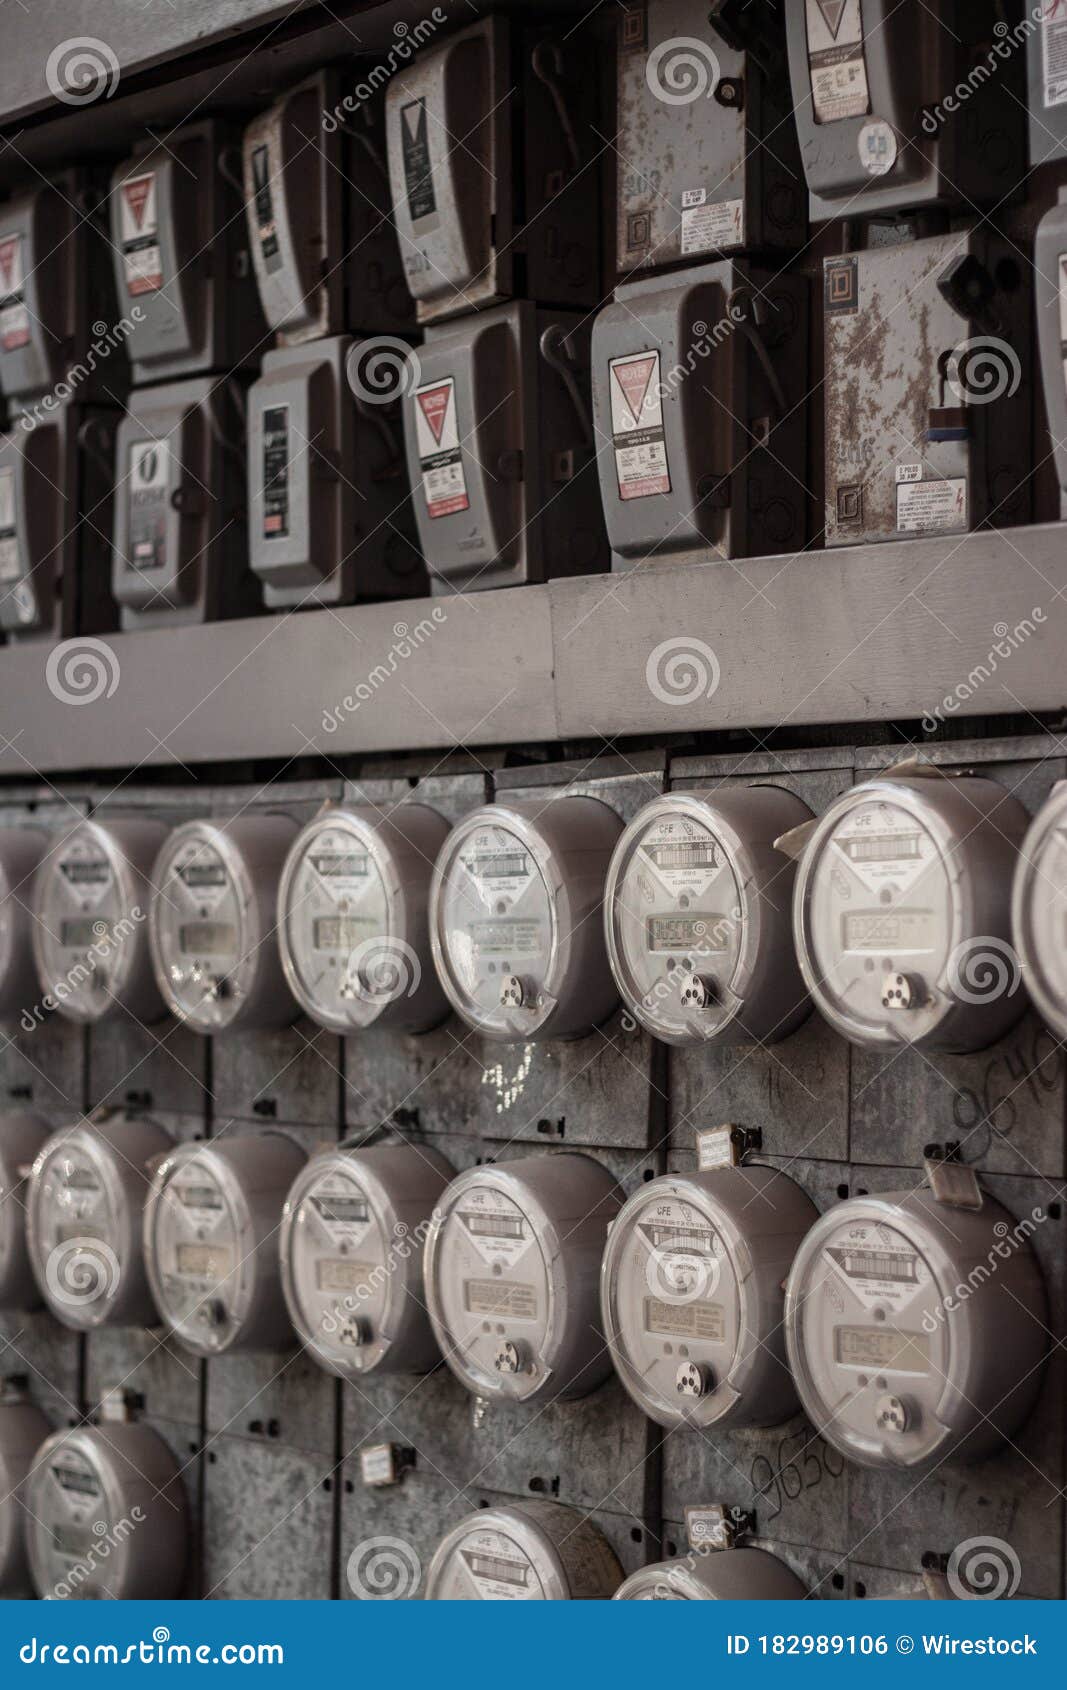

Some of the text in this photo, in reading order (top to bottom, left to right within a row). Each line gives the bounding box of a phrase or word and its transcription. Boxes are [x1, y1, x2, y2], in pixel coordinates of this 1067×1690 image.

[855, 815, 872, 826] CFE
[658, 823, 674, 834] CFE
[657, 1206, 672, 1217] CFE
[848, 1228, 866, 1239] CFE
